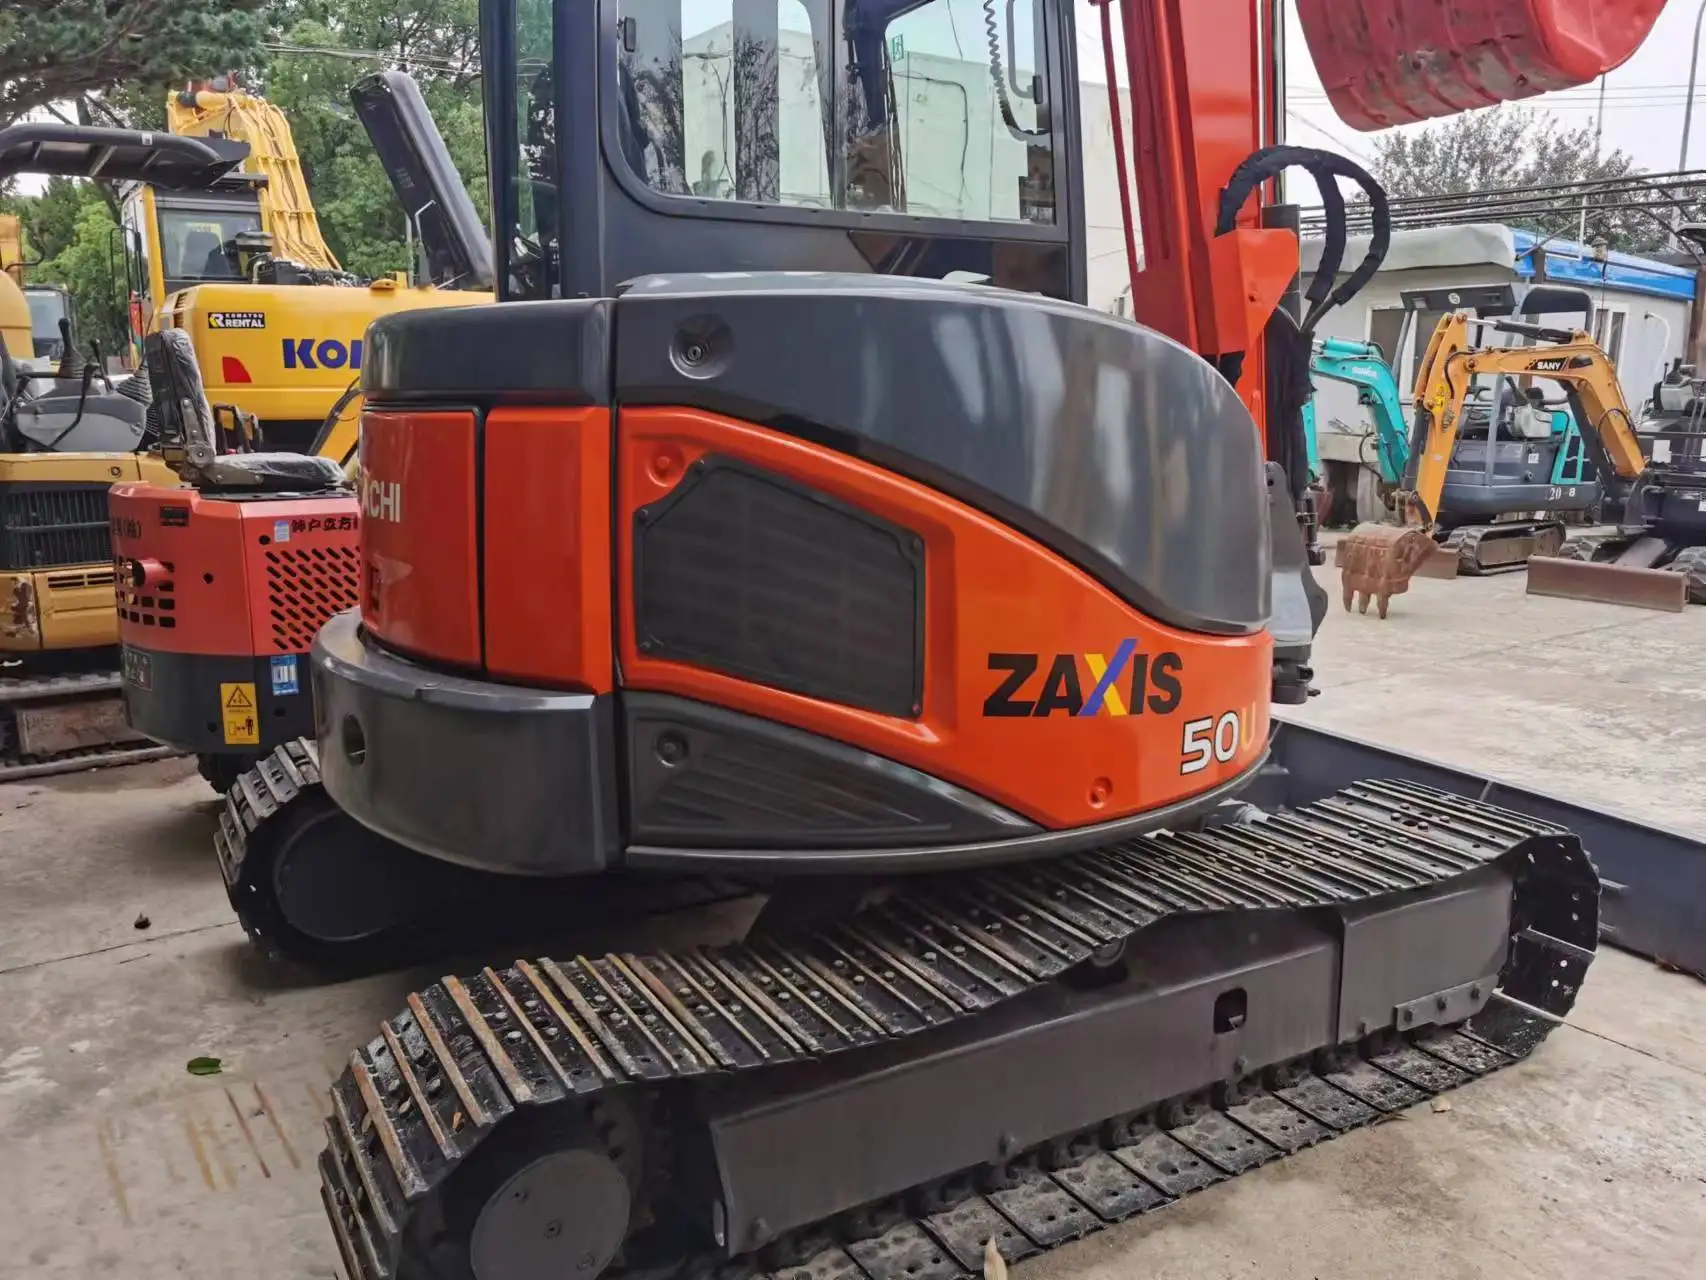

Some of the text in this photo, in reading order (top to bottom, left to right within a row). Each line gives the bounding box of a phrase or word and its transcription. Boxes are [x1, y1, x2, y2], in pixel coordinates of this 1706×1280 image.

[225, 319, 265, 328] RENTAL
[1537, 361, 1561, 370] SANY
[983, 638, 1183, 718] ZAXIS
